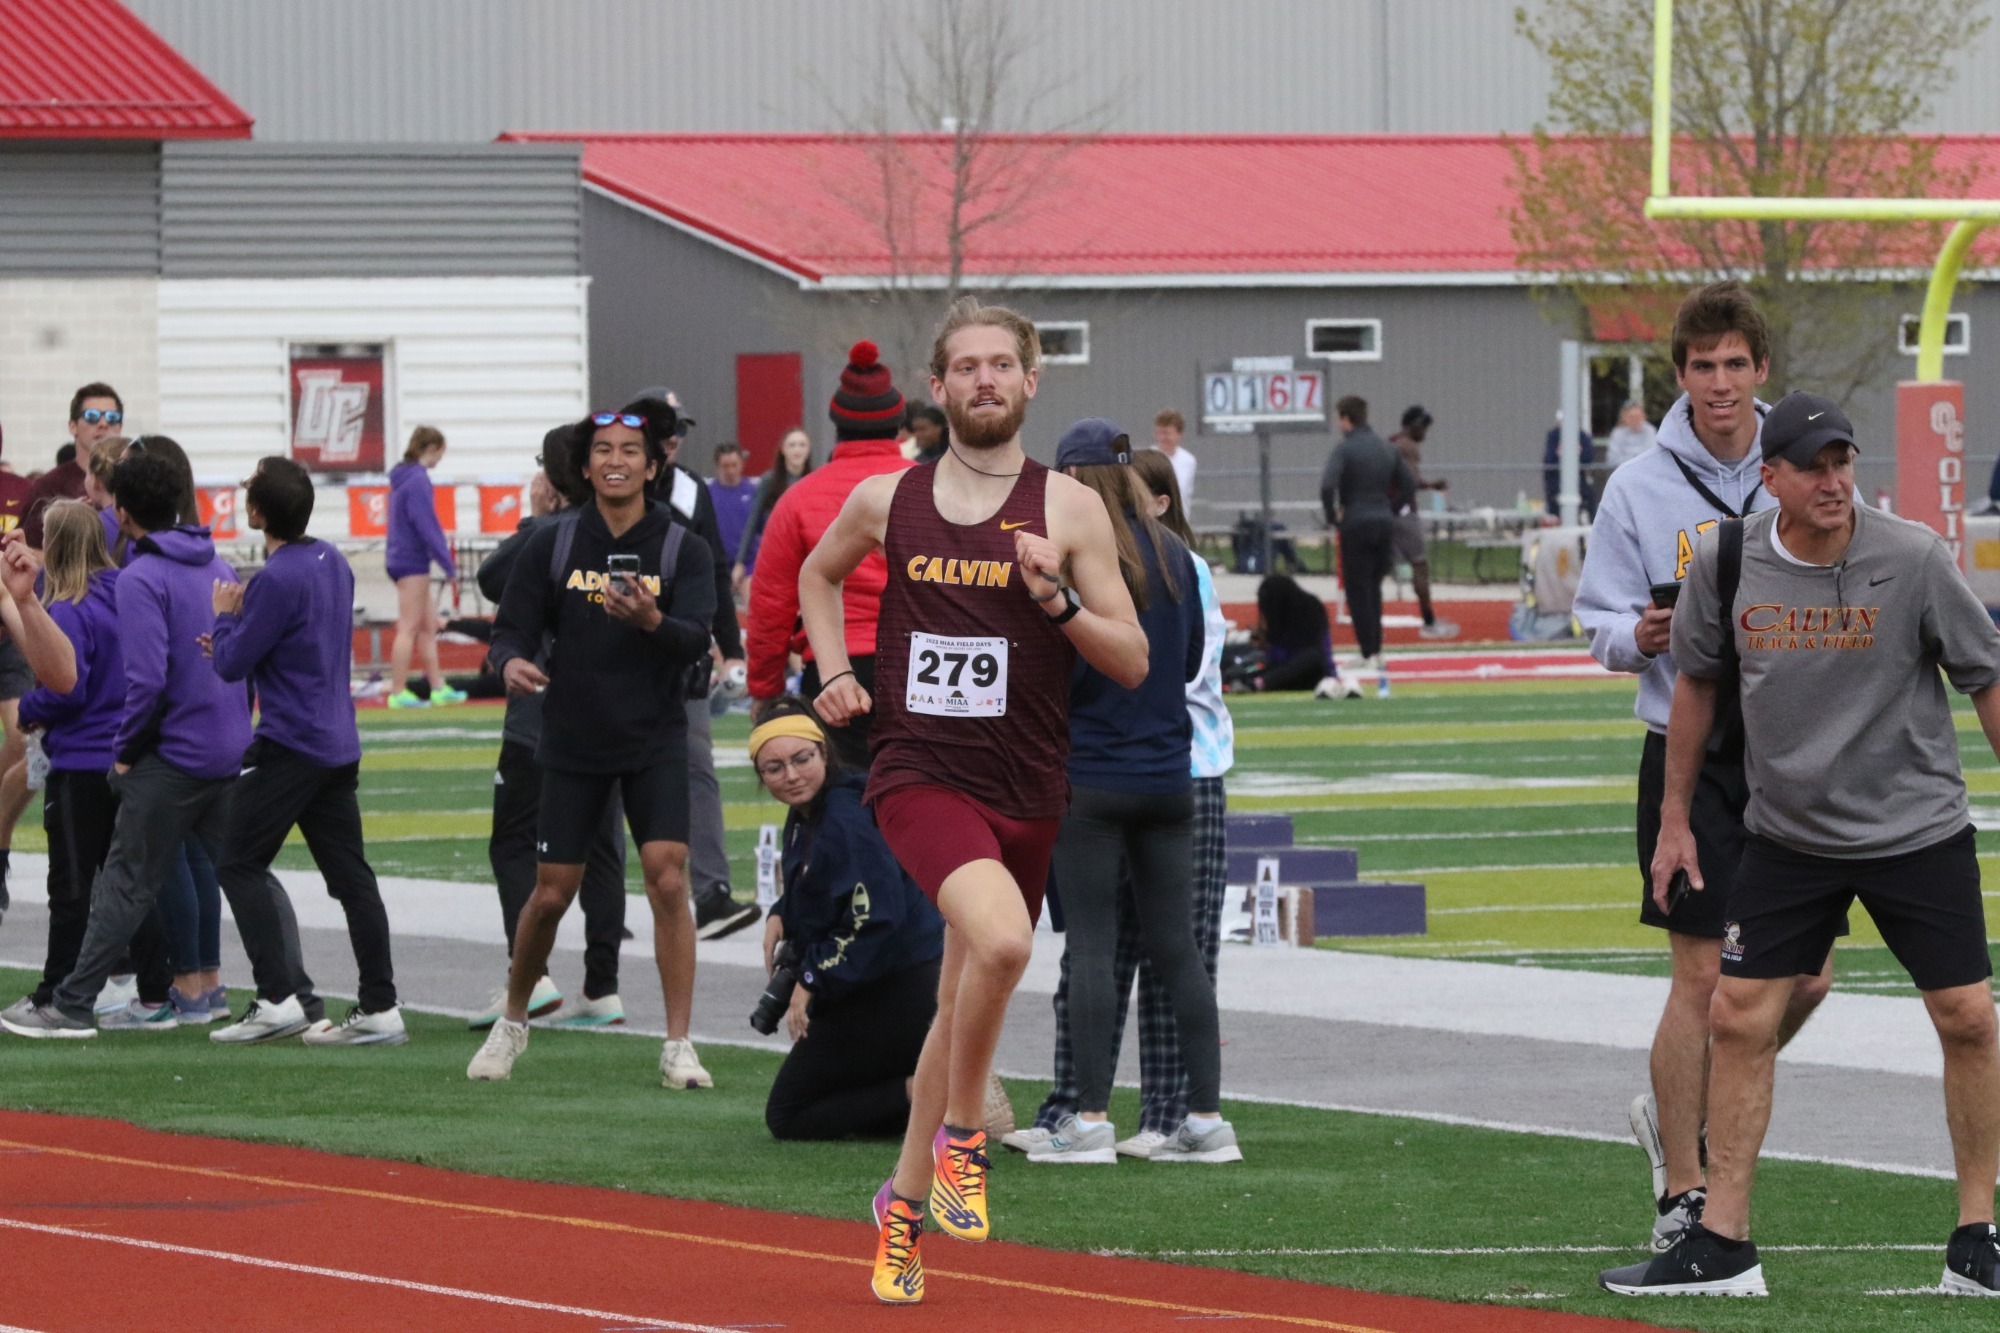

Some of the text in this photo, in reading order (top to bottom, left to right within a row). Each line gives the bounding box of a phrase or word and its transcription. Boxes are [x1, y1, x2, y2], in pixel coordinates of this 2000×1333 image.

[907, 555, 1013, 587] CALVIN
[1740, 604, 1880, 632] CALVIN
[1747, 635, 1874, 650] TRACK & FIELD
[917, 650, 998, 687] 279
